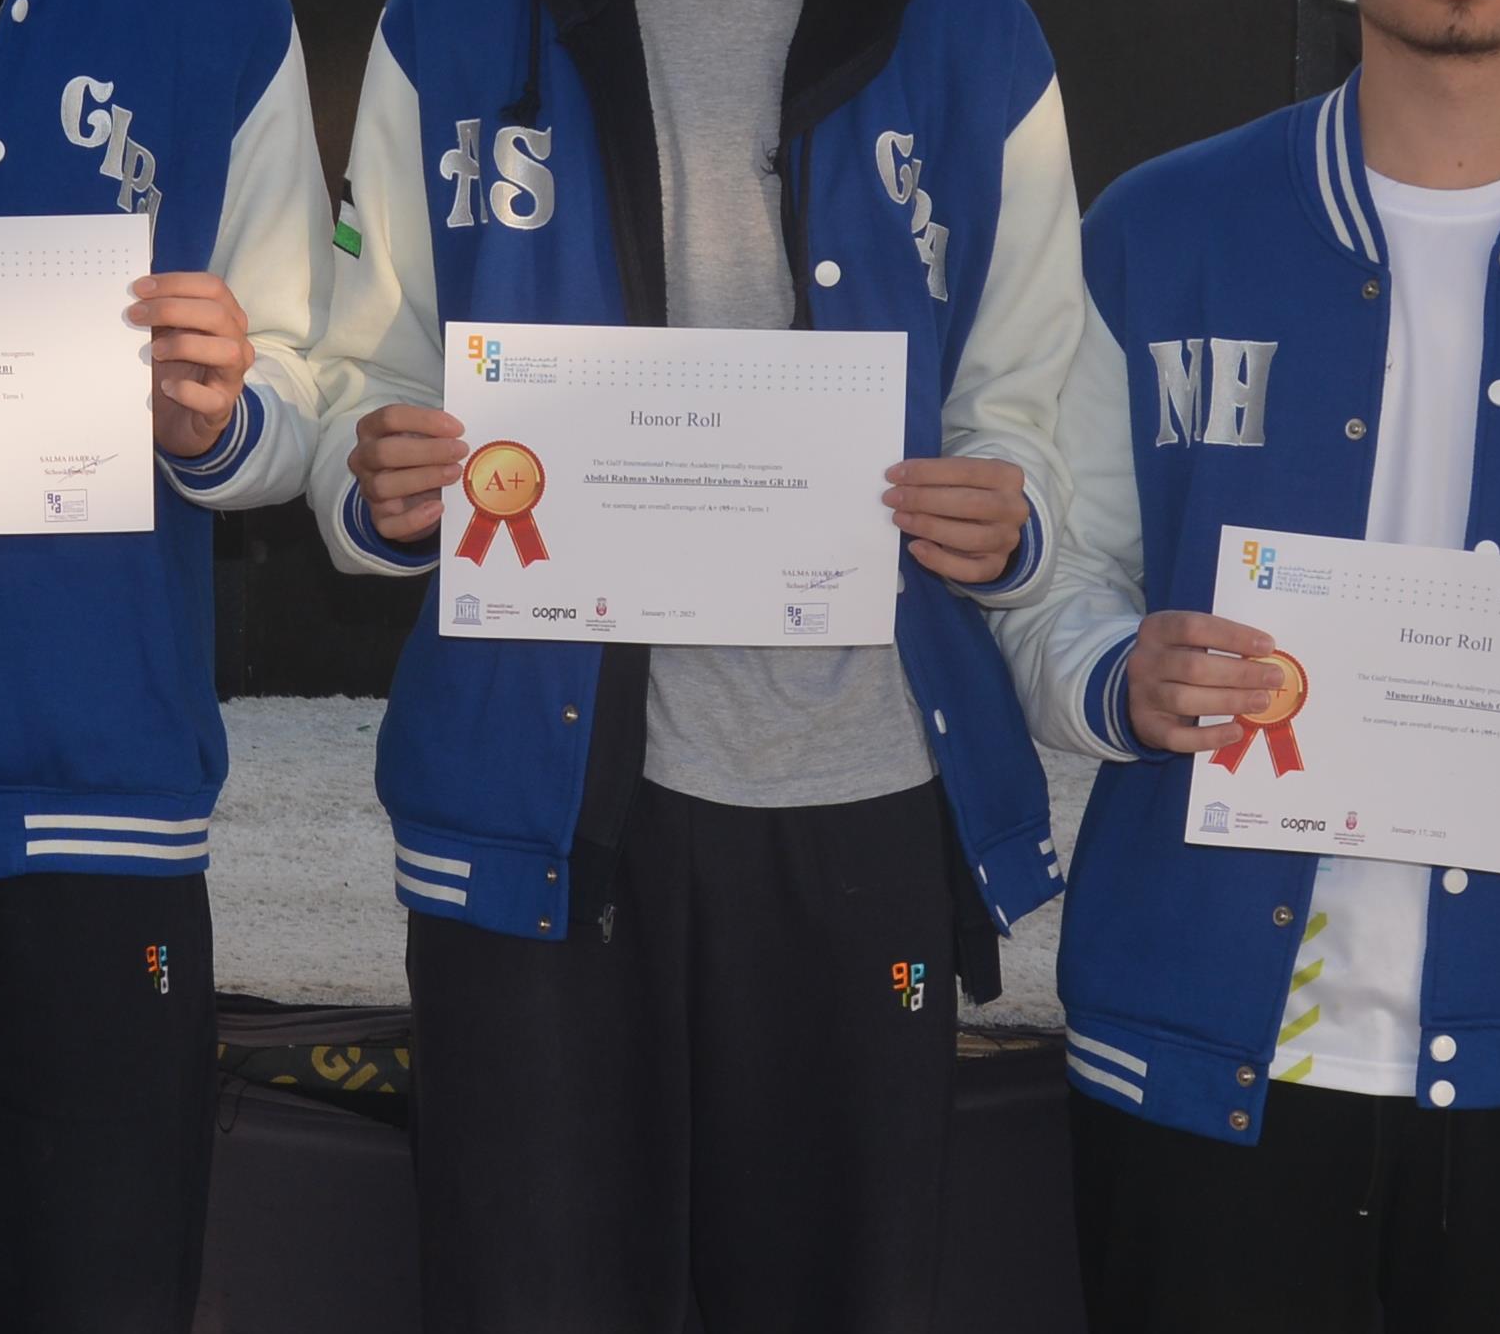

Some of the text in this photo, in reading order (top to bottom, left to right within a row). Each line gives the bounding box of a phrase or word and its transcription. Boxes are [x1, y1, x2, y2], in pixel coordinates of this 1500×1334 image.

[630, 410, 720, 427] Honor Roll
[484, 469, 526, 493] A+
[532, 607, 576, 621] cognia
[1399, 627, 1492, 652] Honor Roll
[1280, 816, 1326, 834] cognia
